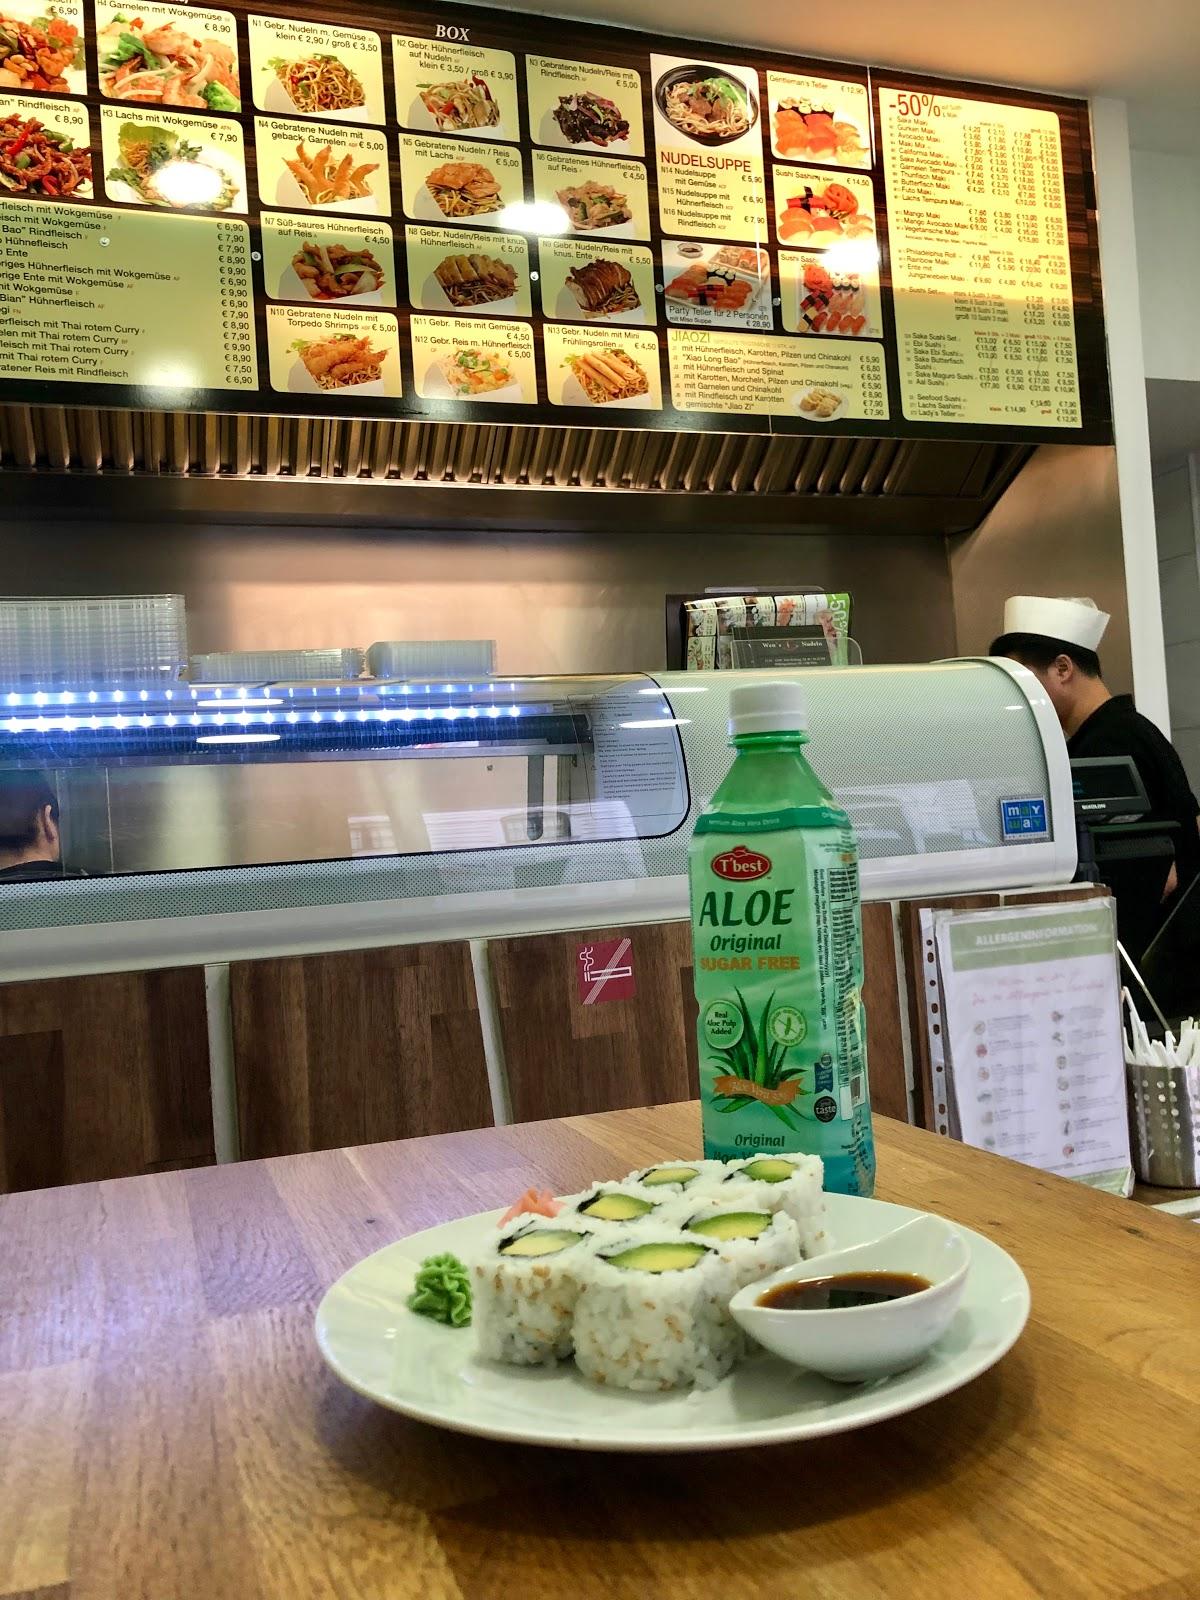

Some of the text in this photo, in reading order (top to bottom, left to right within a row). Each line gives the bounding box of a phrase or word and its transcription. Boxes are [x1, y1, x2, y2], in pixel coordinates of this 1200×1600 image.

[110, 1, 150, 11] Garnelen
[168, 8, 222, 20] Wokgemüse
[212, 24, 231, 33] 8,90
[264, 20, 286, 30] Gebr.
[289, 24, 318, 34] Nudeln
[332, 30, 366, 42] Gemüse
[435, 24, 472, 42] BOX
[276, 32, 296, 41] klein
[306, 36, 324, 45] 2,90
[332, 40, 351, 48] groß
[360, 43, 378, 52] 3,50
[396, 39, 485, 59] N2 Gebr. Hühnerfleisch
[18, 99, 70, 112] Rindfleisch
[890, 94, 941, 117] -50%
[103, 109, 113, 118] H3
[116, 110, 143, 121] Lachs
[162, 116, 218, 129] Wokgemüse
[259, 120, 364, 140] N4 Gebratene Nudeln mit
[219, 133, 238, 143] 7,90
[308, 135, 346, 149] Garnelen
[366, 142, 384, 151] 5,00
[414, 139, 456, 151] Gebratene
[458, 145, 486, 155] Nudeln
[430, 150, 454, 160] Lachs
[661, 151, 752, 173] NUDELSUPPE
[562, 164, 580, 173] Reis
[36, 206, 112, 220] mit Wokgemüse
[29, 227, 82, 240] Rindfleisch
[264, 218, 274, 226] N7
[327, 223, 384, 235] Hühnerfleisch
[294, 231, 312, 239] Reis
[28, 262, 171, 281] Hühnerfleisch mit Wokgemüse
[23, 272, 124, 288] Ente mit Wokgemüse
[29, 296, 95, 308] Hühnerfleisch
[270, 308, 285, 316] N10
[287, 309, 331, 319] Gebratene
[334, 312, 363, 321] Nudeln
[44, 320, 59, 328] mit
[61, 321, 82, 330] Thai
[114, 325, 140, 336] Curry
[287, 318, 359, 331] Torpedo Shrimps
[429, 318, 450, 327] Gebr.
[455, 320, 472, 328] Reis
[488, 323, 520, 331] Gemüse
[548, 326, 560, 334] N13
[561, 327, 581, 336] Gebr.
[583, 329, 609, 337] Nudeln
[430, 336, 451, 344] Gebr.
[452, 338, 469, 346] Reis
[482, 340, 532, 350] Hühnerfleisch
[672, 330, 710, 342] JIAOZI
[35, 365, 129, 378] Reis mit Rindfleisch
[719, 858, 762, 872] T'best
[699, 888, 795, 926] ALOE
[710, 934, 782, 953] Original
[700, 956, 800, 972] SUGAR FREE
[816, 1106, 837, 1114] taste
[735, 1134, 785, 1148] Original
